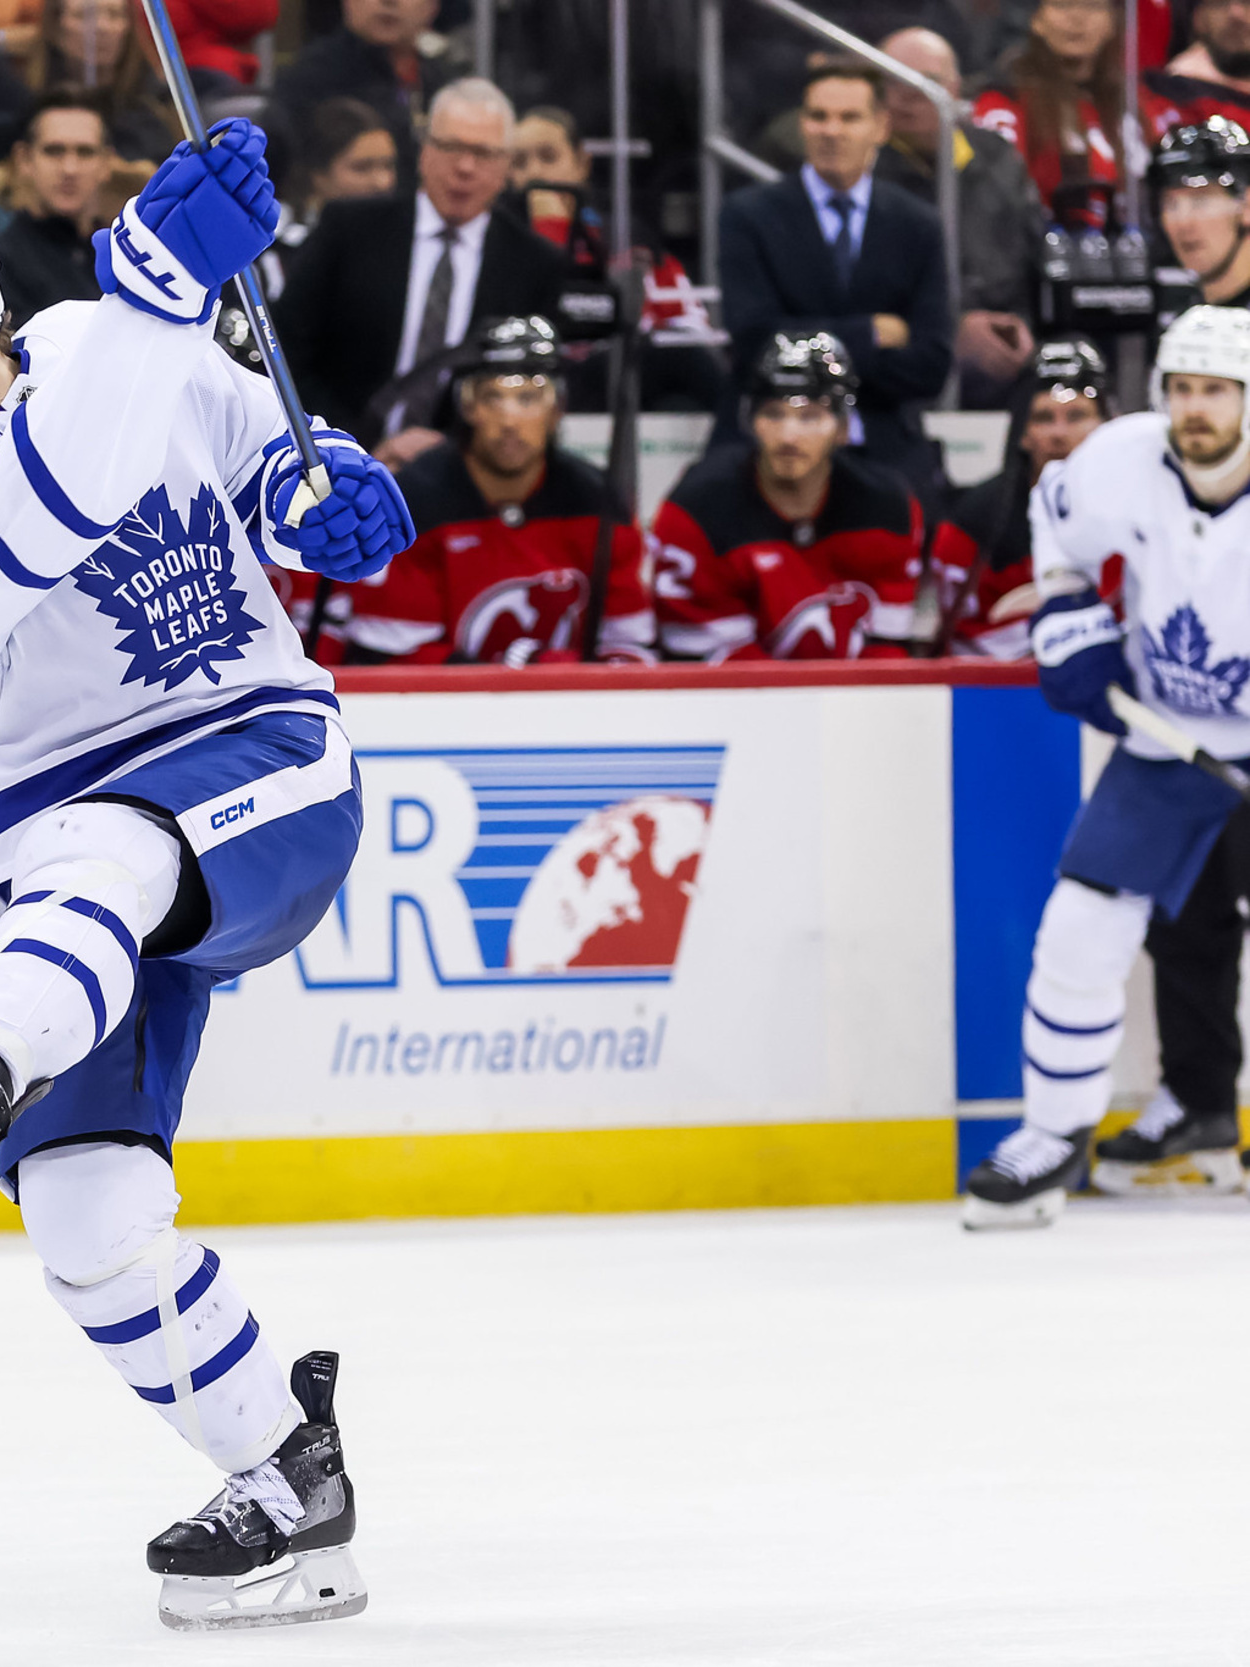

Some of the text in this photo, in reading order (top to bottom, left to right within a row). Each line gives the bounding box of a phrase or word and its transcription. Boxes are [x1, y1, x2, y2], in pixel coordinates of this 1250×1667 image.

[112, 543, 223, 609] TORONTO
[143, 571, 222, 625] MAPLE
[151, 599, 228, 652] LEAFS
[210, 796, 255, 831] CCM
[328, 1012, 669, 1076] International
